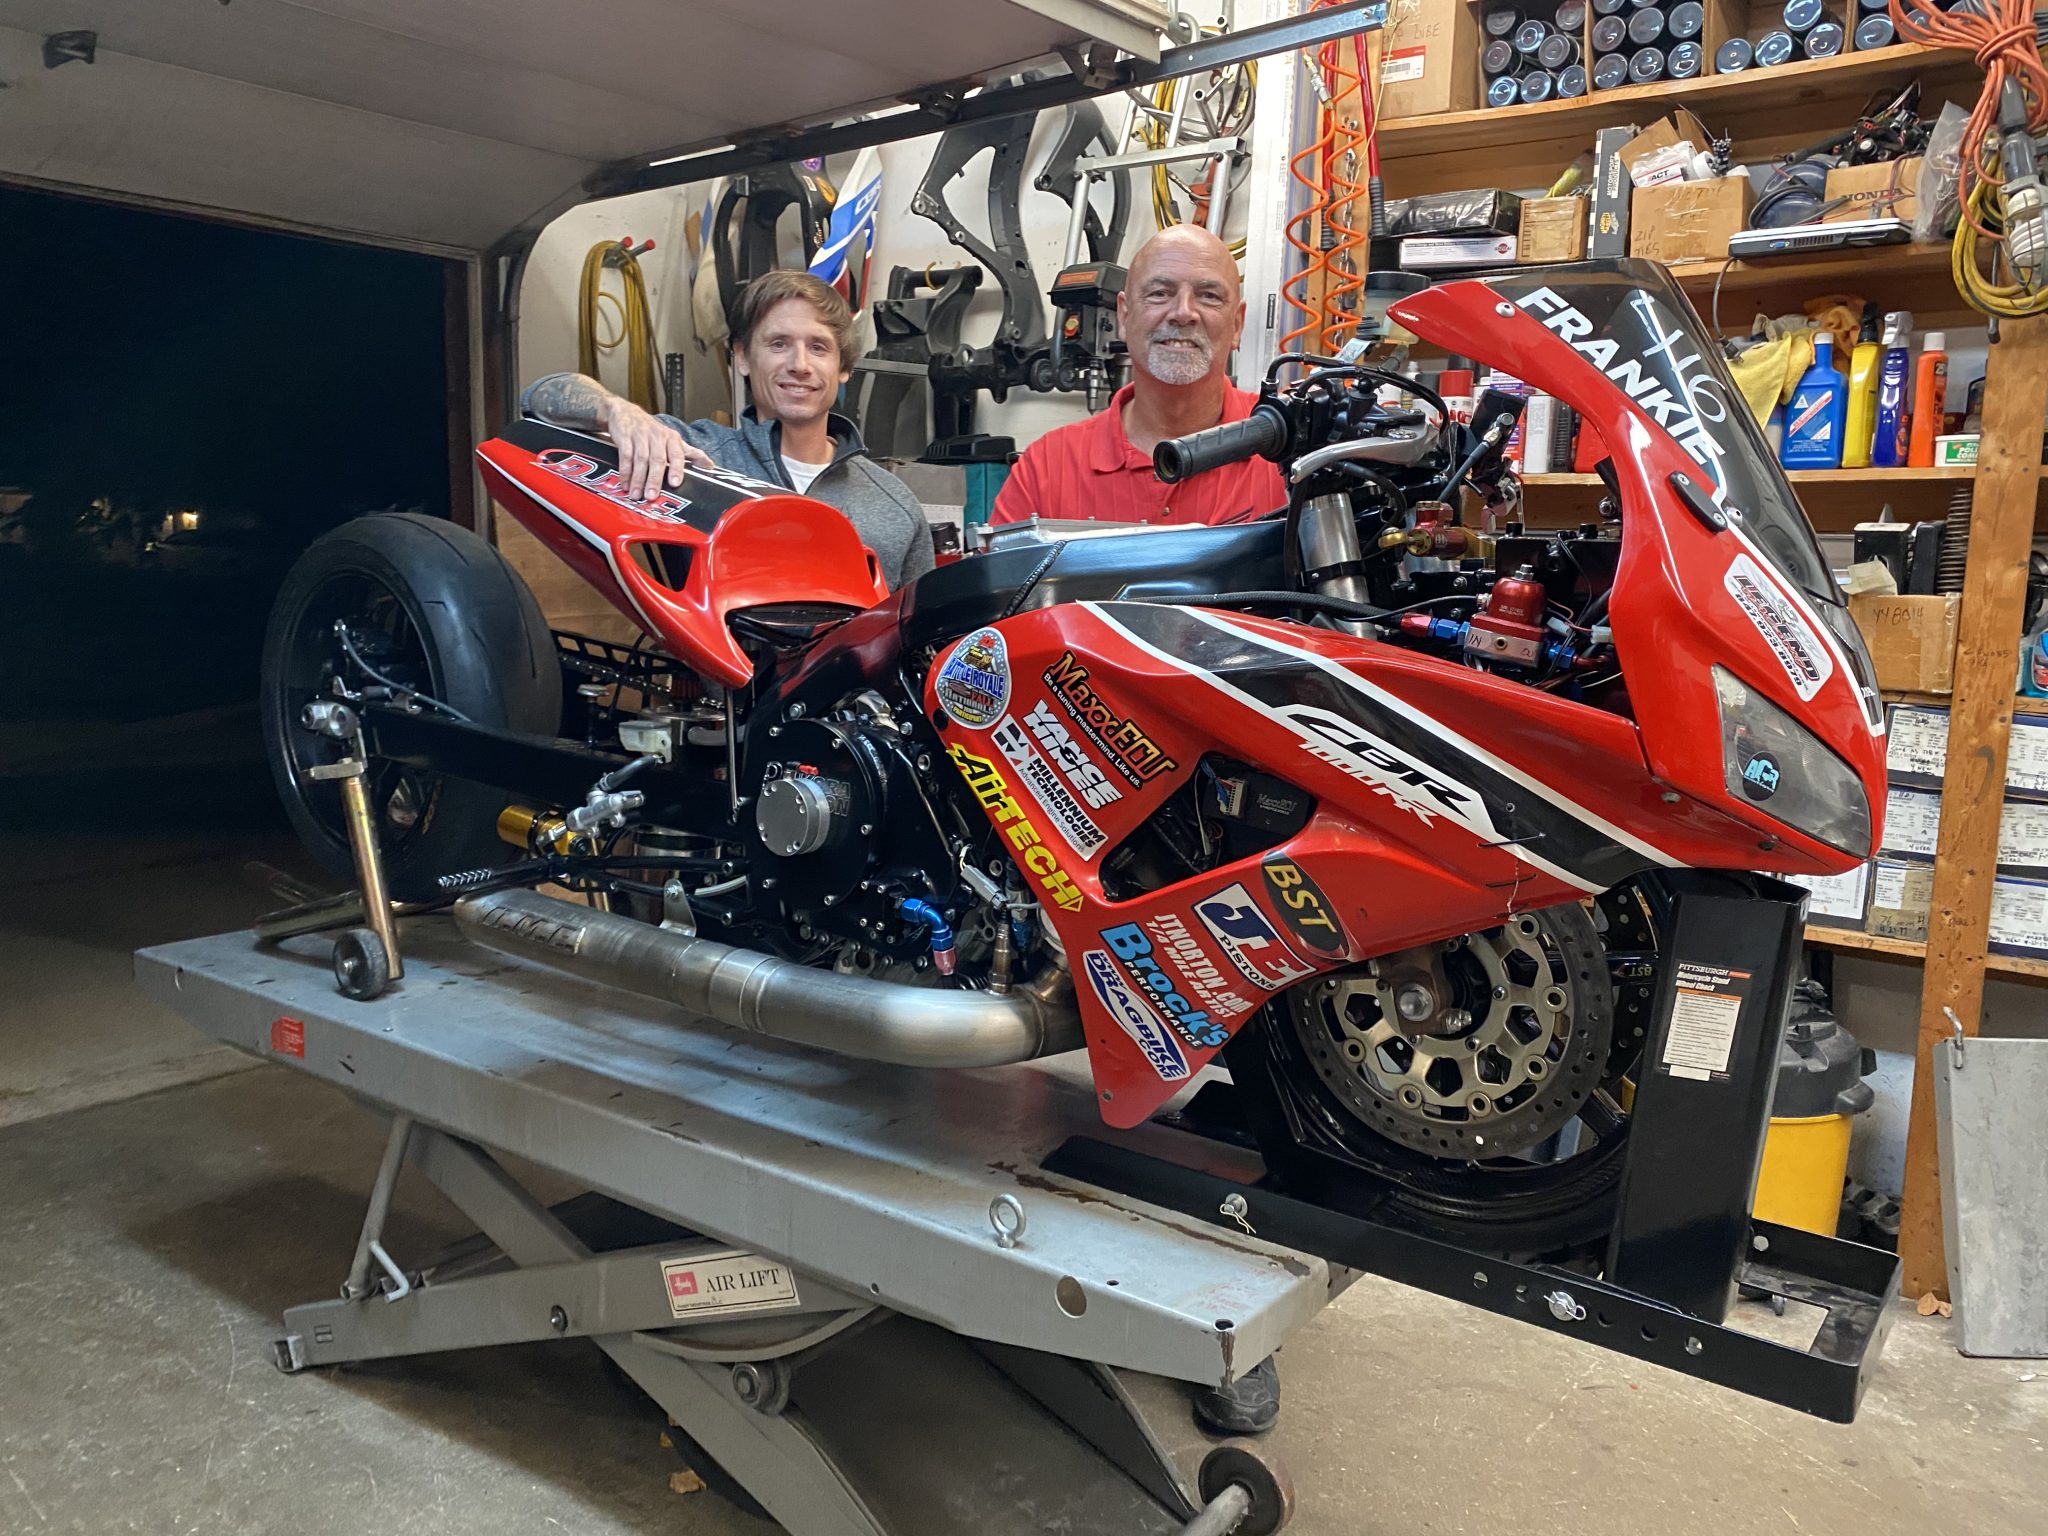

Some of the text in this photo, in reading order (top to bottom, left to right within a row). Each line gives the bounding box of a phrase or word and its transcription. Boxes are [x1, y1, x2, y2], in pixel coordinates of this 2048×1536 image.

[1634, 225, 1656, 242] ZIP
[1515, 286, 1726, 465] FRANKIE
[1733, 576, 1820, 681] LEGEND
[1022, 713, 1107, 810] HINES
[1034, 699, 1124, 803] VANCE
[1043, 673, 1054, 687] Be
[1057, 689, 1078, 717] tuning
[1075, 714, 1115, 762] mastermind.
[1114, 758, 1130, 776] Like
[1129, 774, 1142, 788] us.
[1018, 768, 1045, 801] Advanced
[1042, 799, 1061, 825] Engine
[1027, 763, 1097, 848] TECHNOLOGIES
[1032, 757, 1106, 843] MILLENNIUM
[1264, 864, 1338, 934] BST
[1100, 922, 1230, 1046] Brock's
[1164, 946, 1197, 980] MILE
[1188, 980, 1239, 1018] ARTIST
[1219, 934, 1277, 989] PISTONS
[1628, 965, 1653, 977] BST
[1678, 963, 1729, 976] PITTSBURGH
[1088, 953, 1187, 1078] DRAGBIKE
[1124, 961, 1204, 1048] PERFORMANCE
[706, 1268, 779, 1293] AIR LIFT
